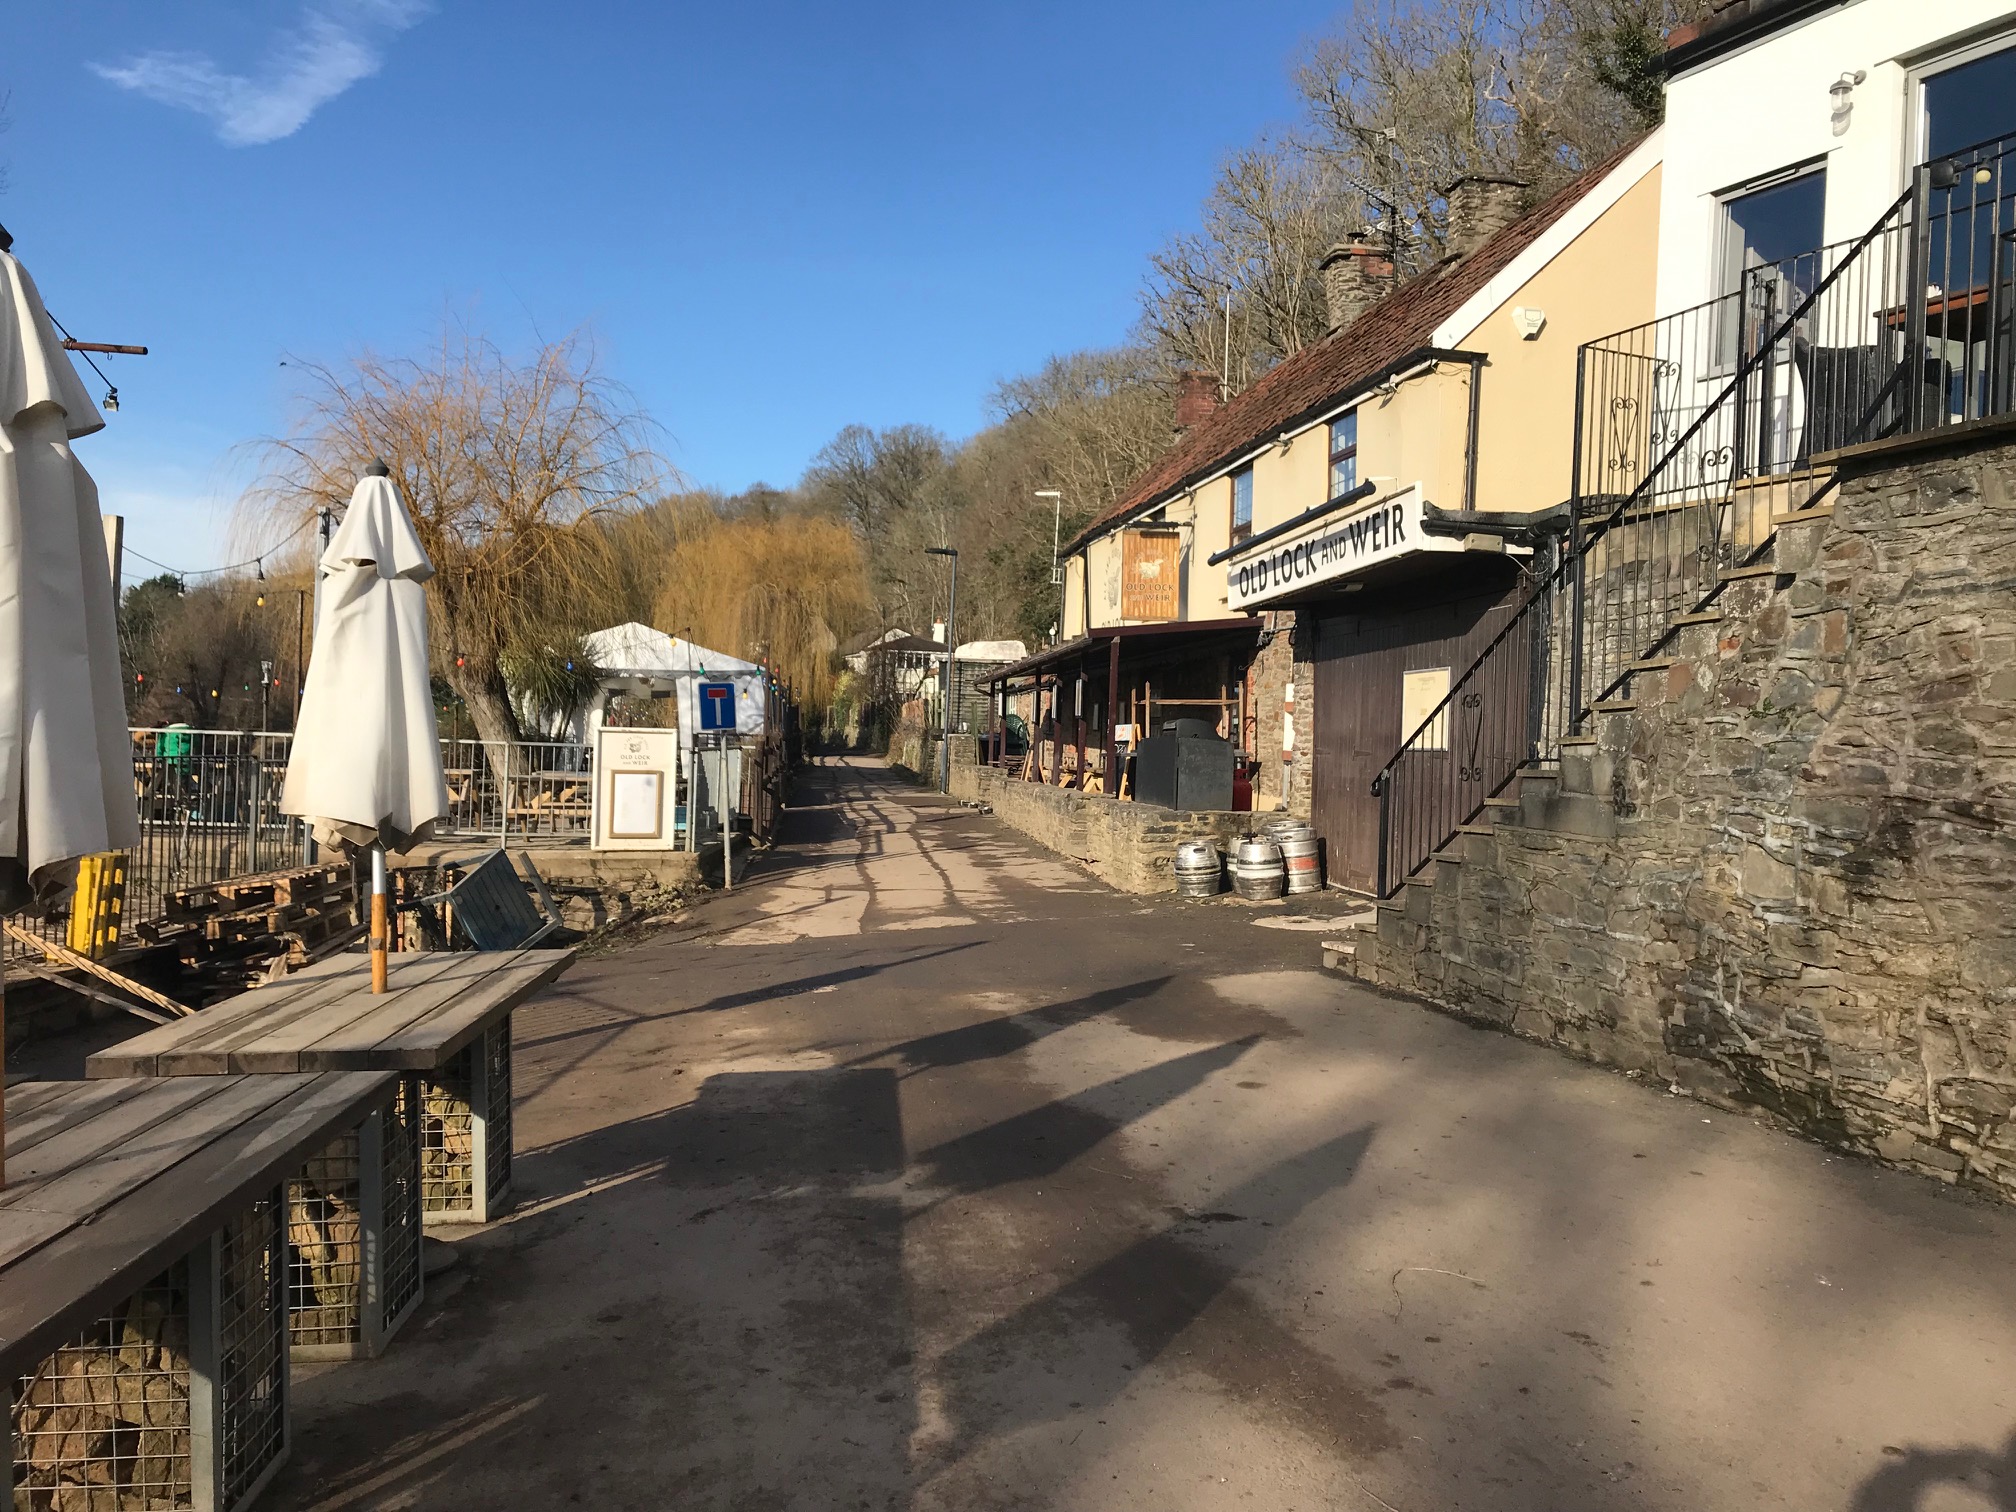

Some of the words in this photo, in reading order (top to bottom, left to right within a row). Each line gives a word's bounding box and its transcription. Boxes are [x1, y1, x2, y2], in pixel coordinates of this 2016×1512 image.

[1239, 559, 1268, 598] OLD
[1273, 539, 1318, 586] LOCK
[1321, 536, 1347, 566] AND
[1349, 503, 1407, 559] WEIR
[1126, 583, 1145, 591] OLD
[1149, 583, 1174, 591] LOCK
[1145, 593, 1170, 601] WEIR
